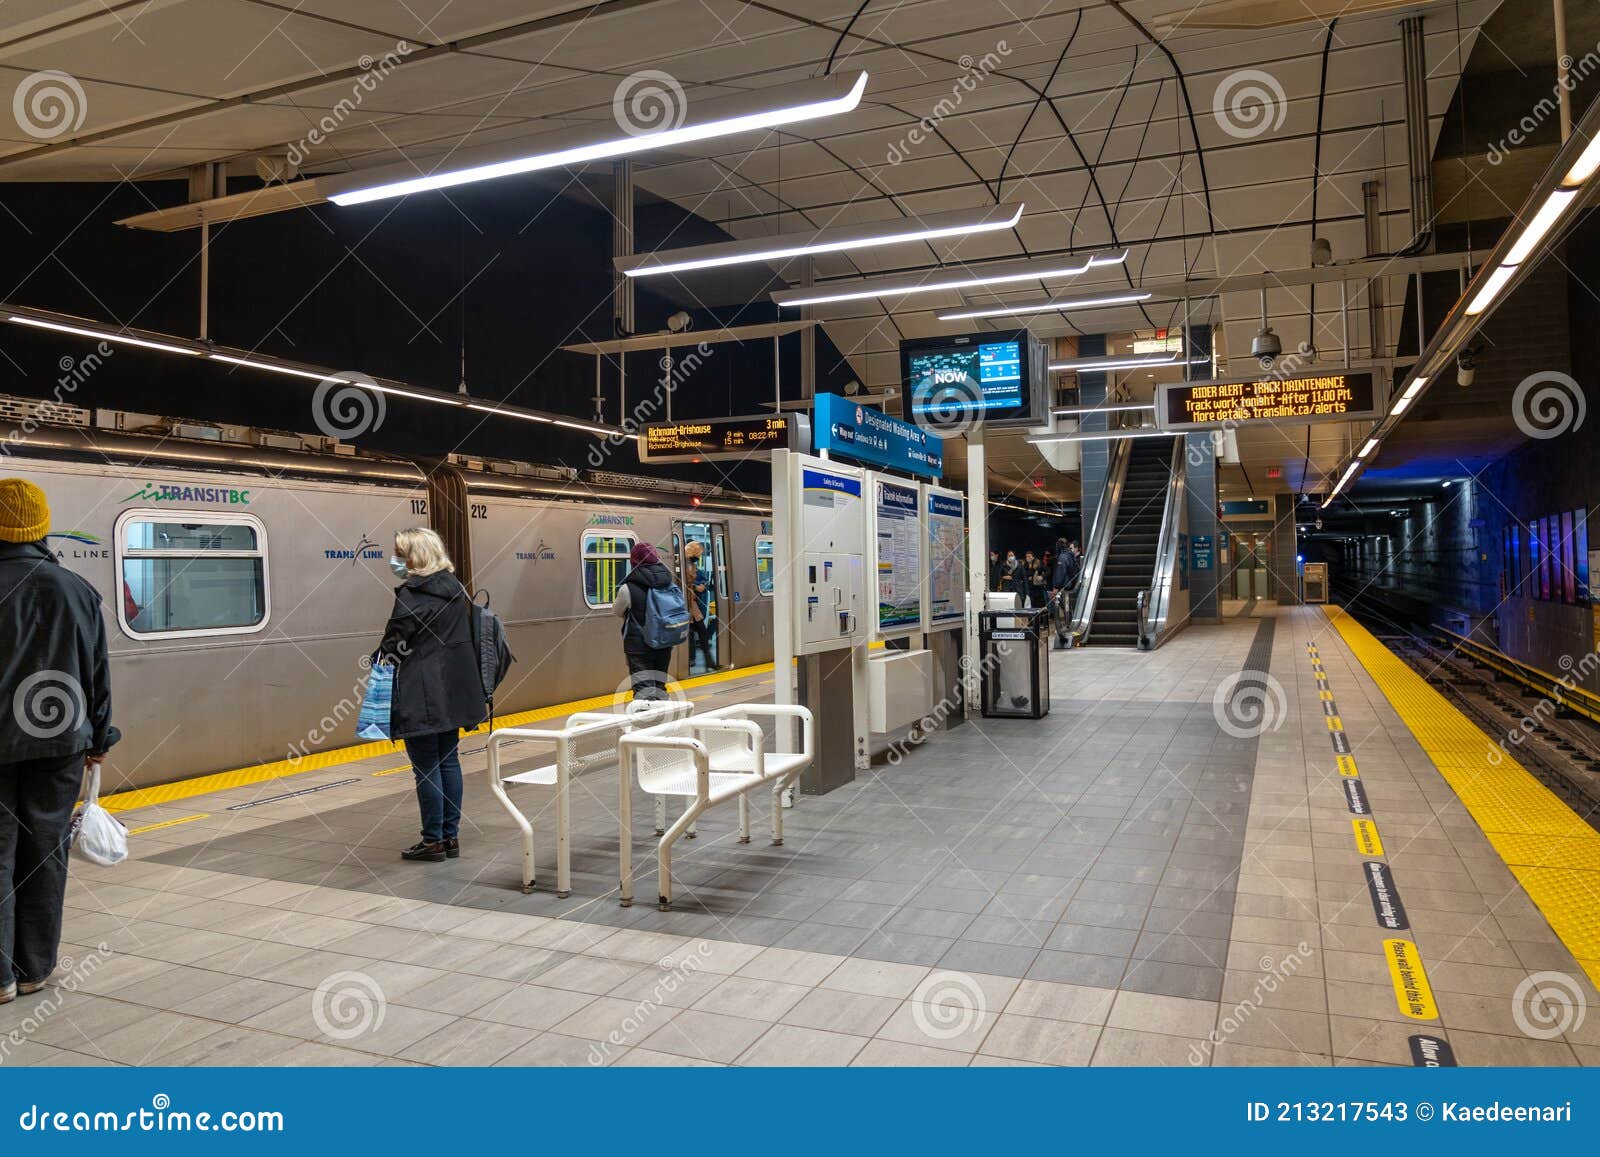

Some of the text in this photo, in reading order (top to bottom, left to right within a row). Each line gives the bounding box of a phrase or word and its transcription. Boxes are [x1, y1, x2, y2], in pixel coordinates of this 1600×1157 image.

[935, 371, 967, 384] NOW
[1192, 386, 1217, 399] RIDER
[1219, 384, 1243, 397] ALERT
[1253, 381, 1281, 394] TRACK
[1282, 376, 1345, 392] MAINTENANCE
[1186, 400, 1212, 411] Track
[1213, 399, 1238, 410] work
[1240, 395, 1275, 408] tonight
[1312, 391, 1335, 402] 11:00
[1193, 401, 1346, 422] More details: translink.ca/alerts
[766, 420, 771, 429] 3
[865, 412, 920, 442] Designated Waiting Area
[411, 500, 427, 515] 112
[471, 504, 488, 519] 212
[325, 550, 384, 560] TRANS LINK
[1391, 941, 1426, 1015] Please wait behind this line
[1419, 1038, 1440, 1061] Allow
